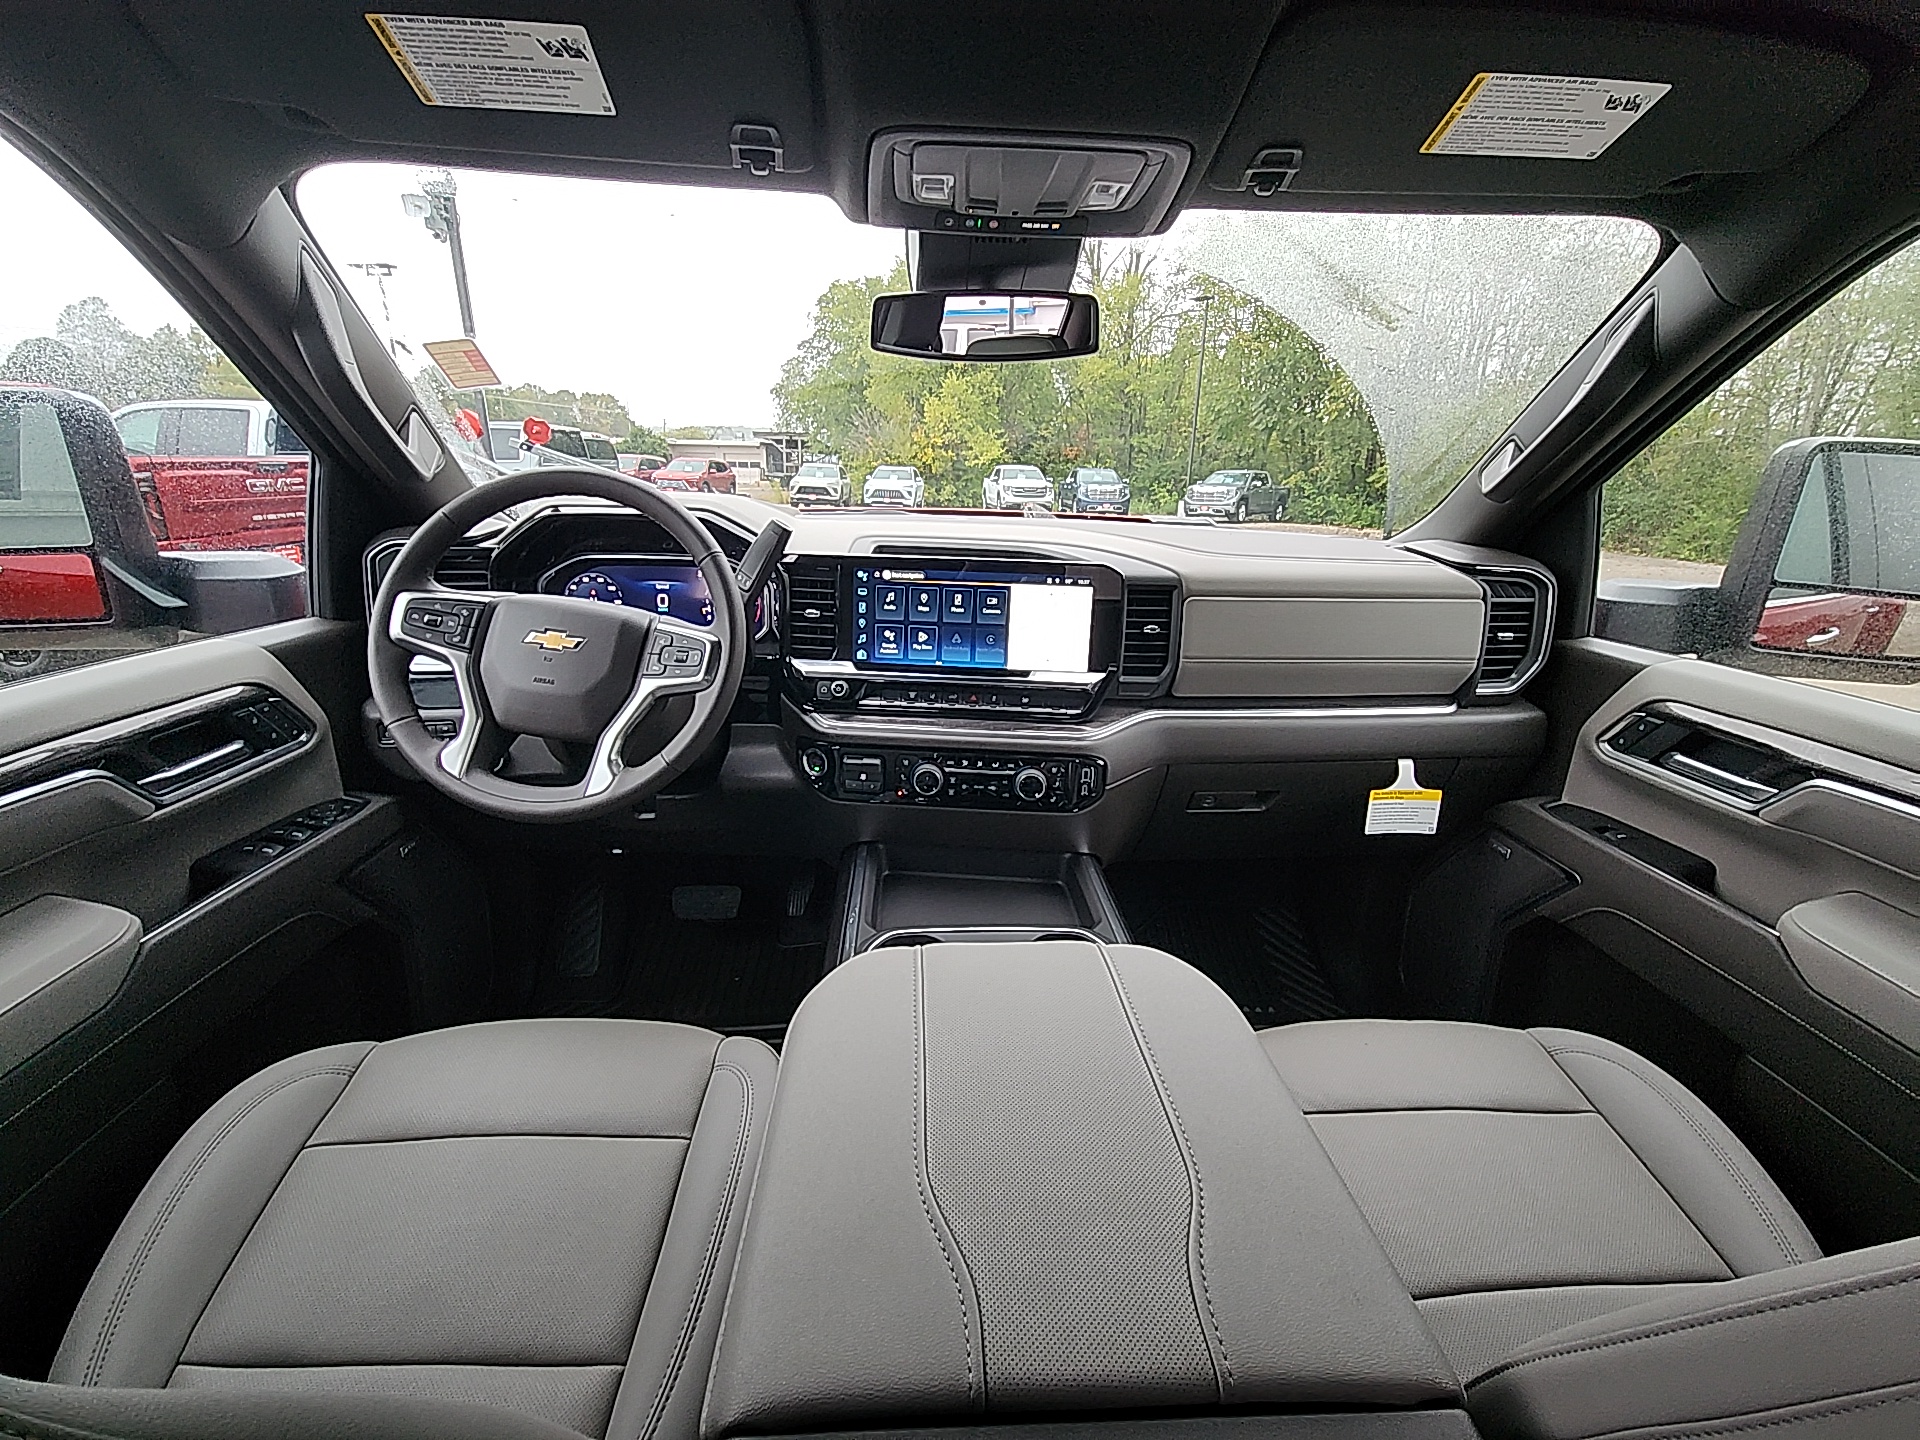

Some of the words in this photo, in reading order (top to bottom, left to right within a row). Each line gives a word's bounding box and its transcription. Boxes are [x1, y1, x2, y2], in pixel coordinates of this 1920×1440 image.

[246, 477, 306, 493] GMC
[252, 511, 306, 521] SIERRA
[656, 593, 669, 607] 0
[532, 676, 556, 686] AIRBAG
